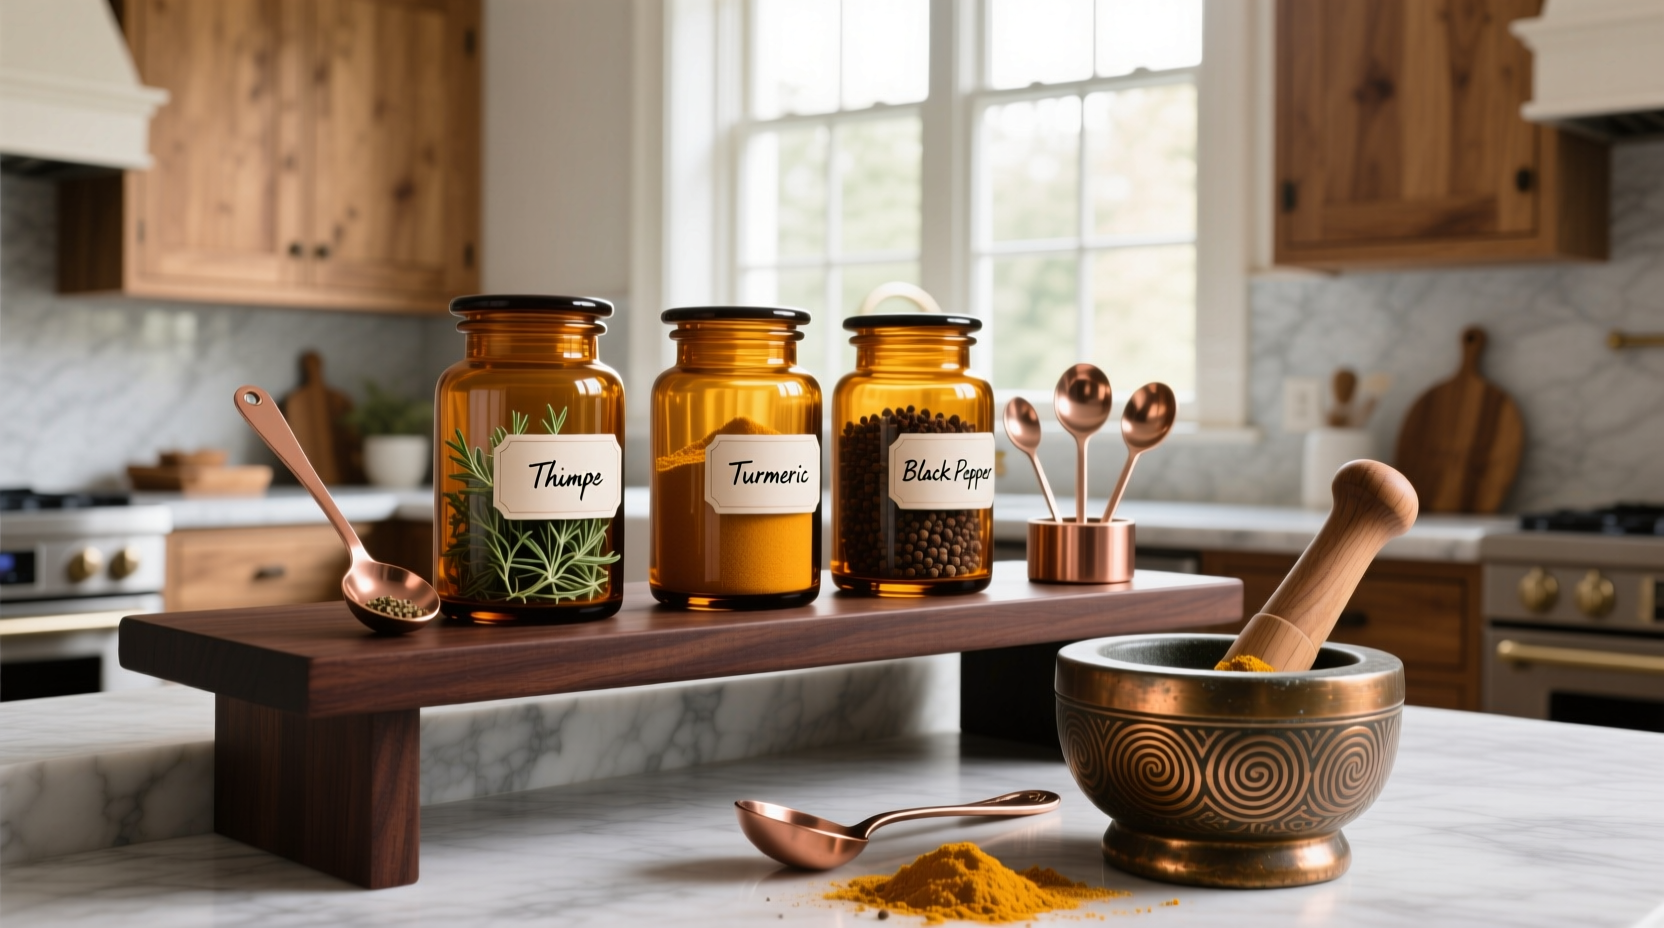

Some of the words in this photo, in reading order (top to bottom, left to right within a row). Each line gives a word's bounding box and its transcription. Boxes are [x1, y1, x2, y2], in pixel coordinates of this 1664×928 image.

[528, 460, 603, 501] Thimpe
[728, 460, 809, 486] Turmeric
[902, 459, 952, 483] Black
[953, 459, 992, 489] Pepper
